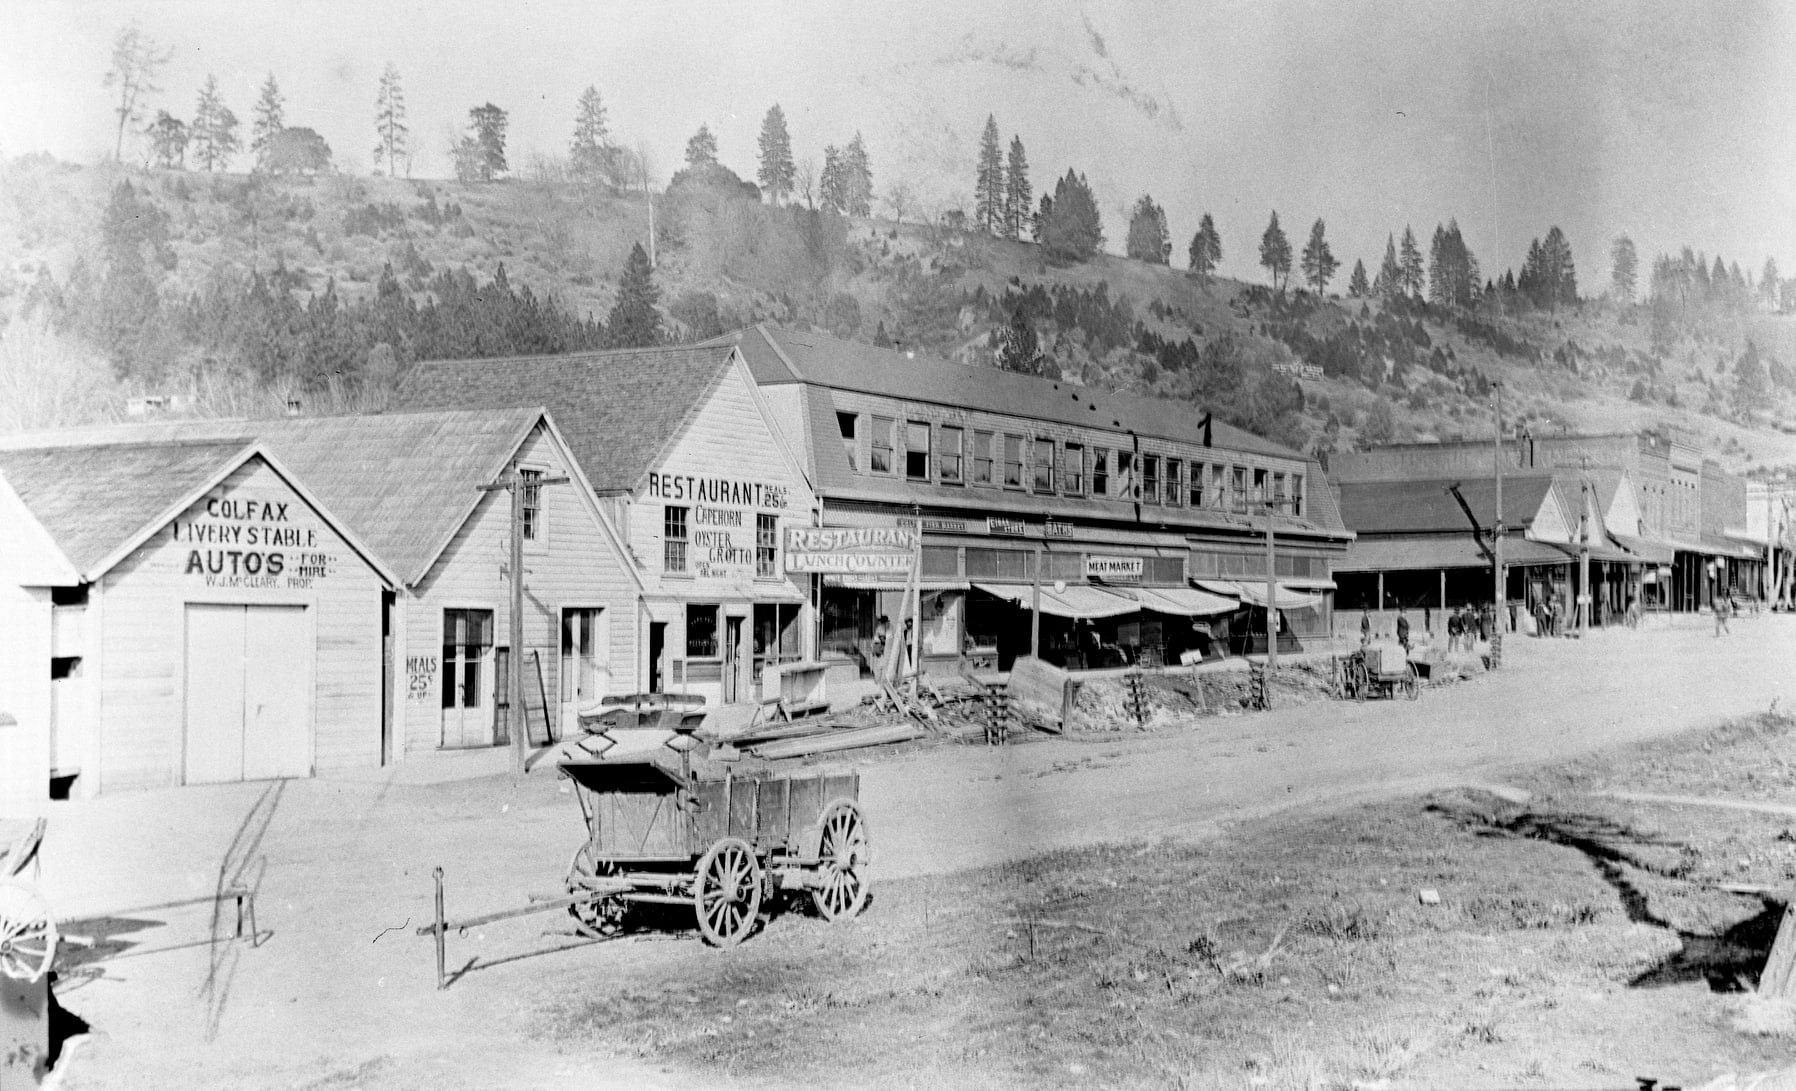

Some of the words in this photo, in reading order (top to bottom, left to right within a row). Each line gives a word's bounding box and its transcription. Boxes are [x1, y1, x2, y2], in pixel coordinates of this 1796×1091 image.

[207, 500, 288, 521] COLFAX
[173, 522, 242, 543] LIVERY
[247, 527, 318, 548] STABLE
[695, 530, 732, 549] OYSTER
[709, 547, 752, 565] GROTTO
[793, 553, 843, 570] LUNCH
[1088, 561, 1107, 572] MEAT
[1109, 561, 1141, 573] MARKET
[406, 656, 437, 673] MEALS
